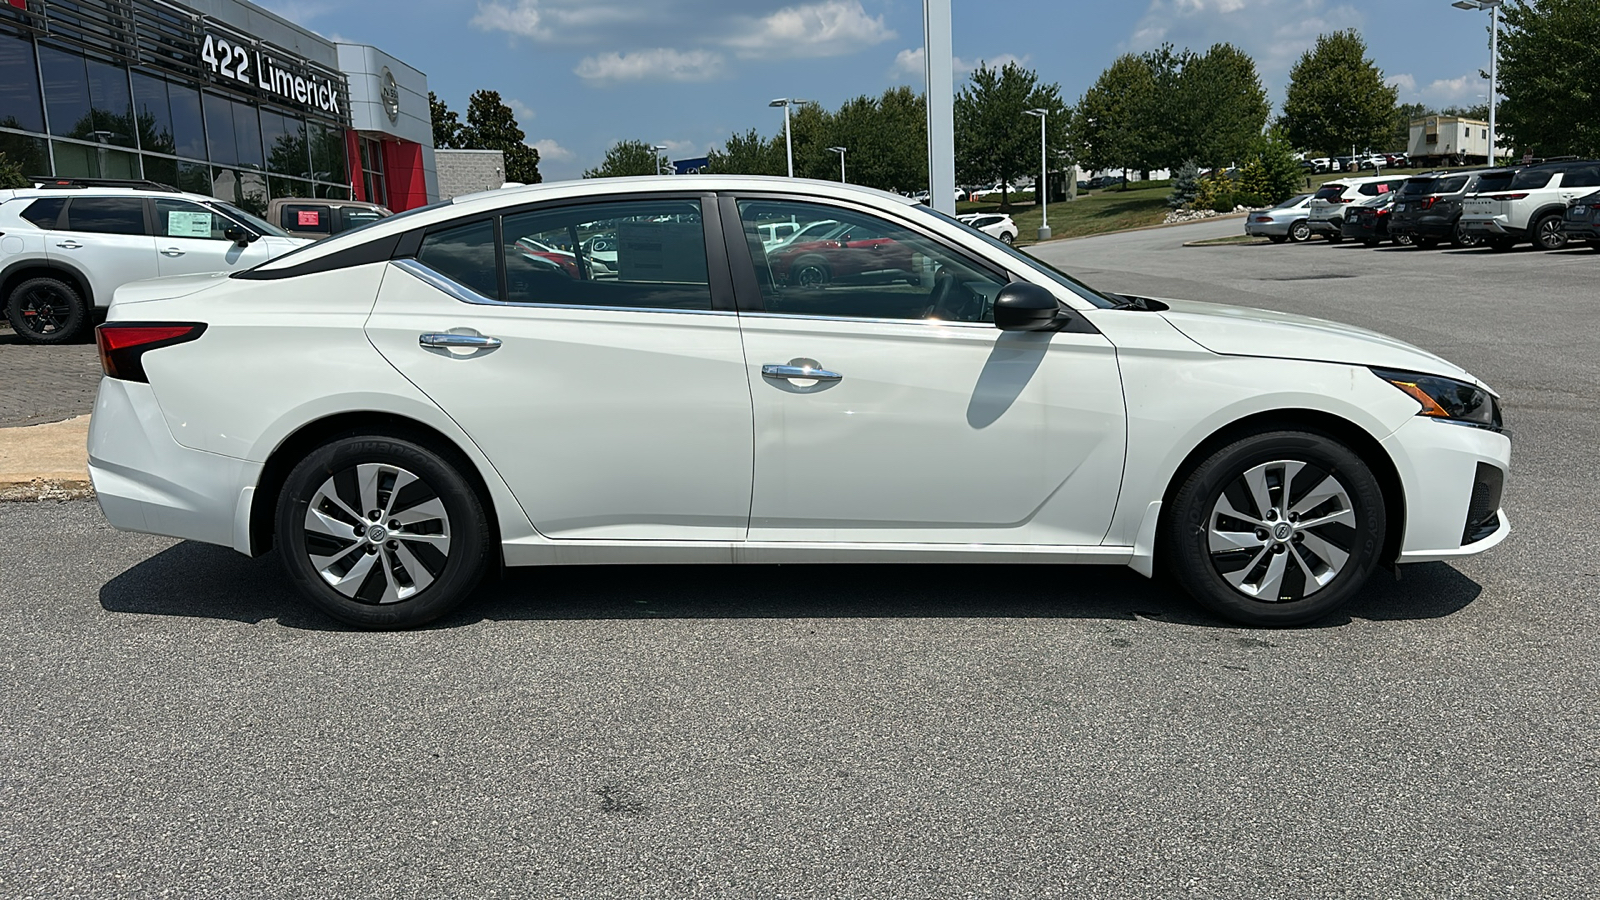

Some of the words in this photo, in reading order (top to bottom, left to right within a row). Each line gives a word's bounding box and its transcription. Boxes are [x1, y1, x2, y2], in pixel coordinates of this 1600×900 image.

[201, 34, 250, 84] 422
[255, 51, 340, 115] Limerick
[383, 87, 399, 100] NSS
